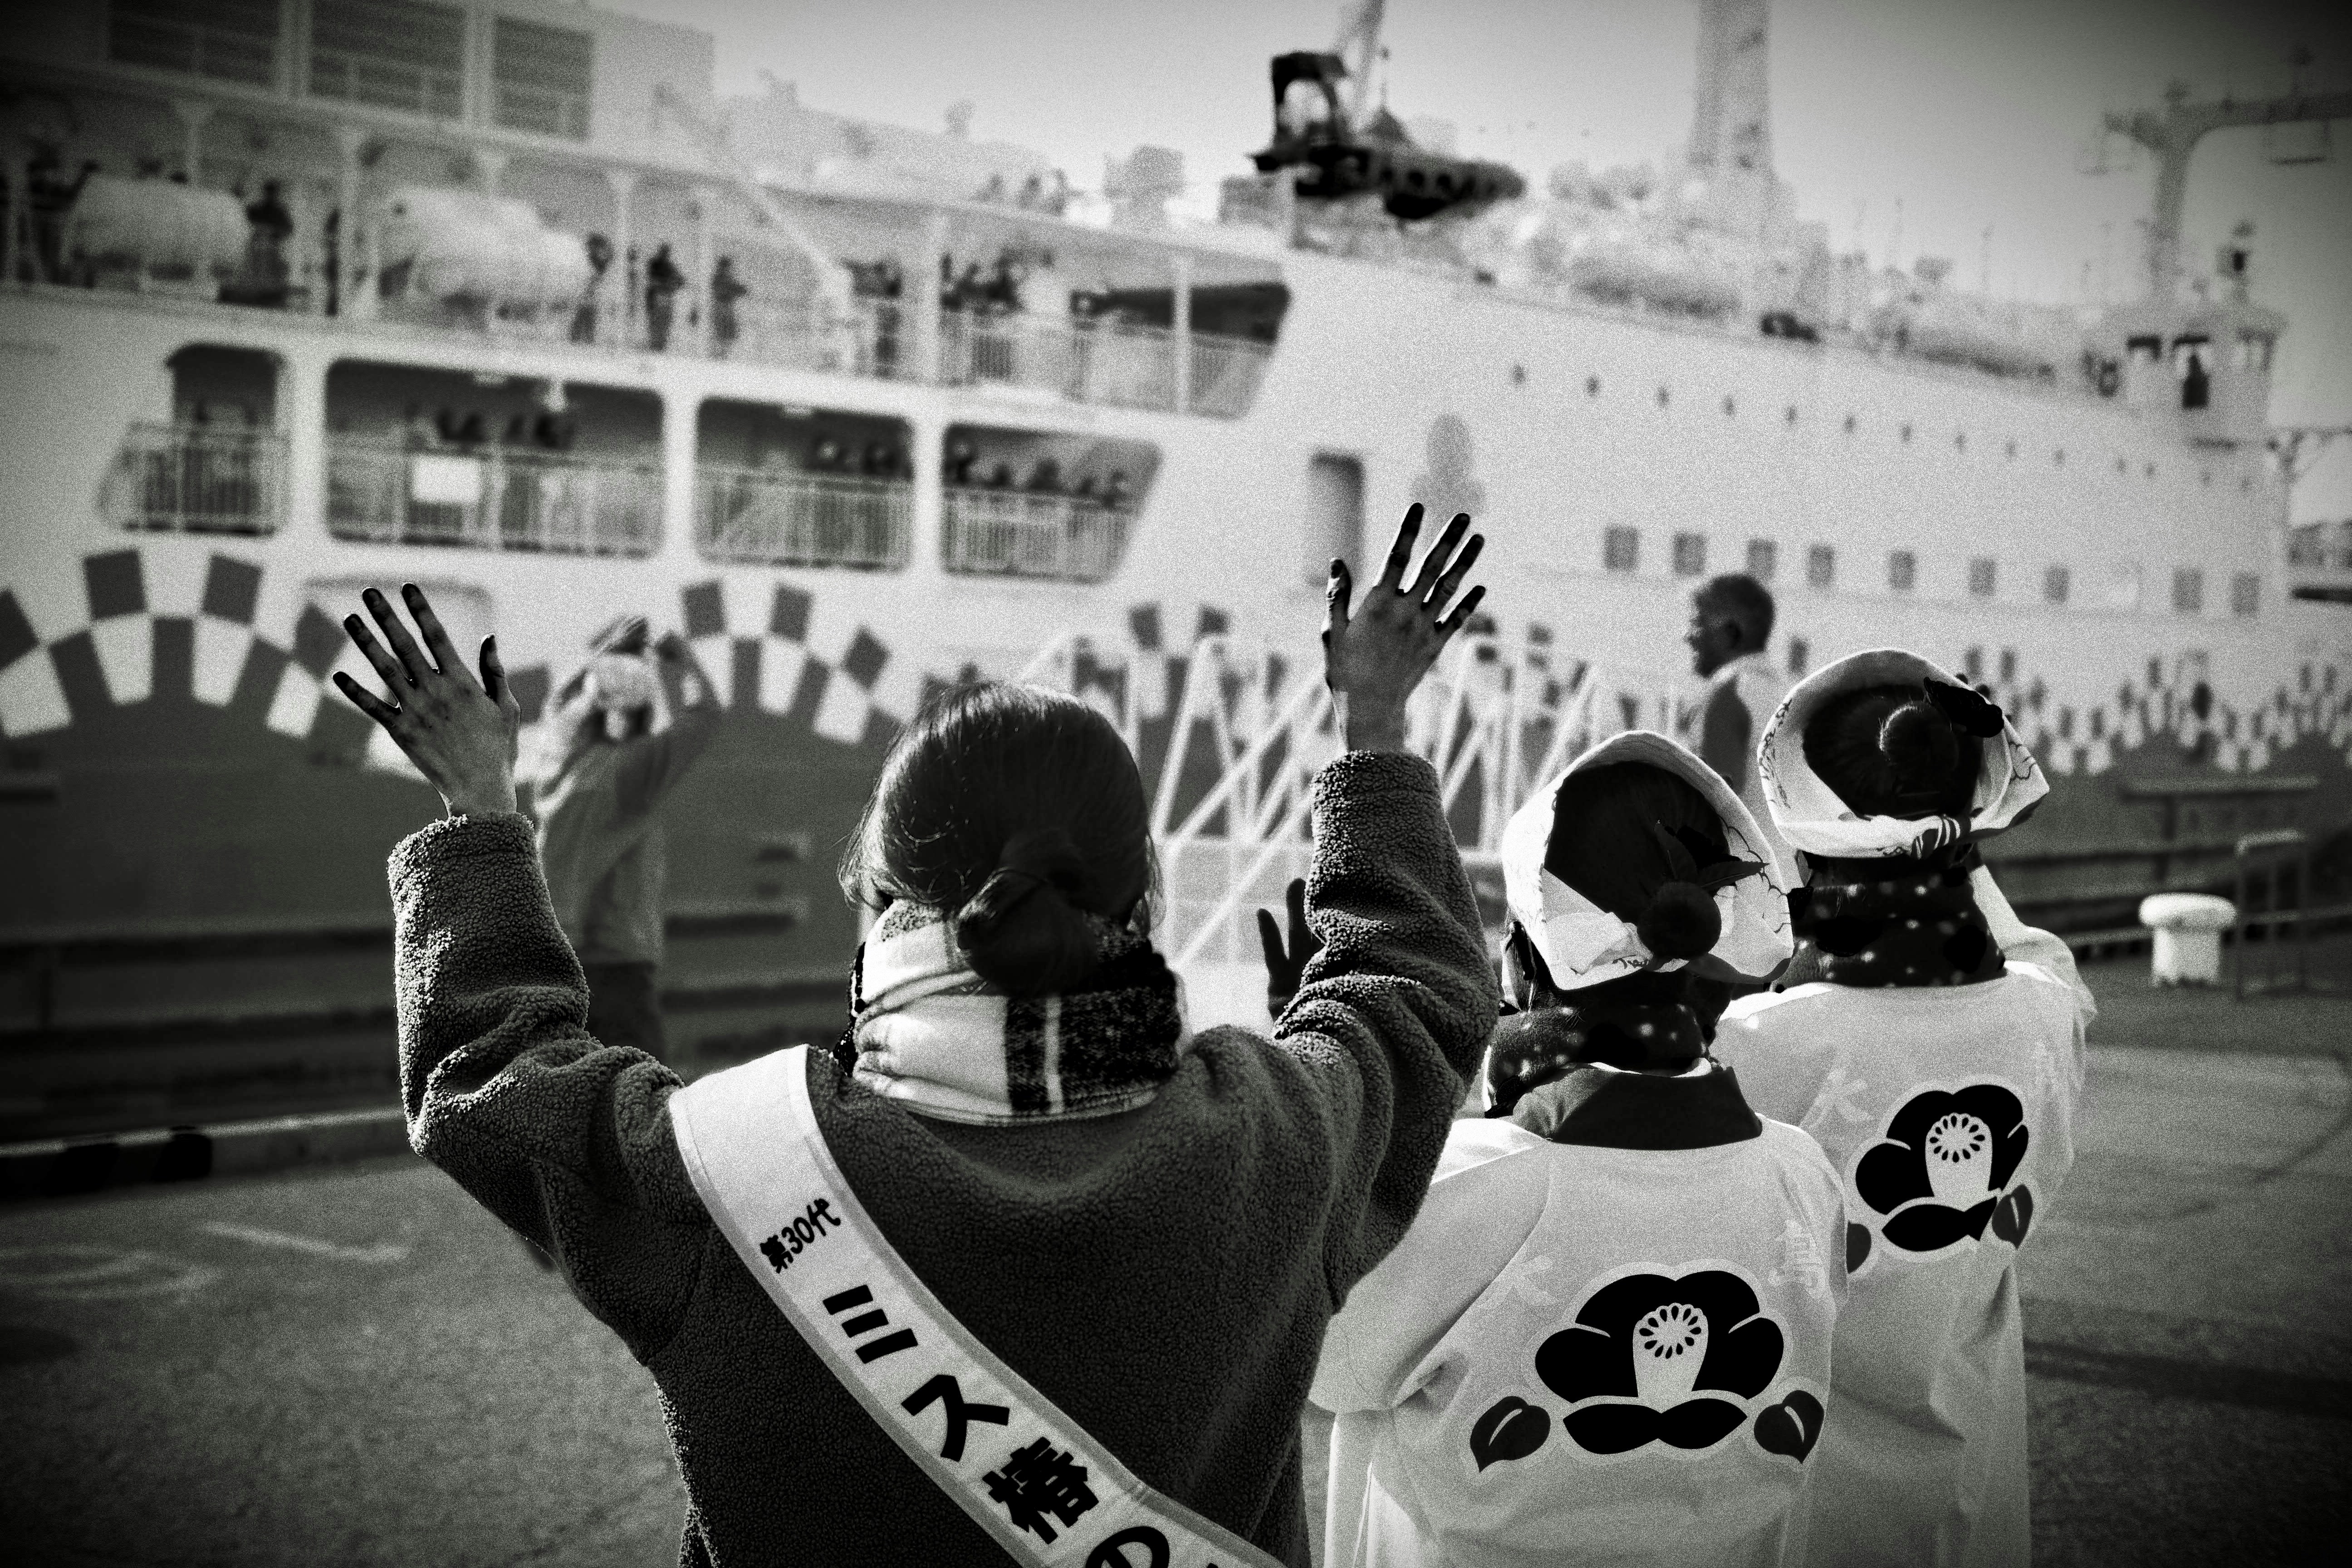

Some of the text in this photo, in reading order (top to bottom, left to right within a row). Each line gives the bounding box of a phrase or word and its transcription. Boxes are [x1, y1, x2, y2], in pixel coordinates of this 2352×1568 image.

[760, 1198, 841, 1274] 第30代
[823, 1284, 1220, 1568] ミス椿の
